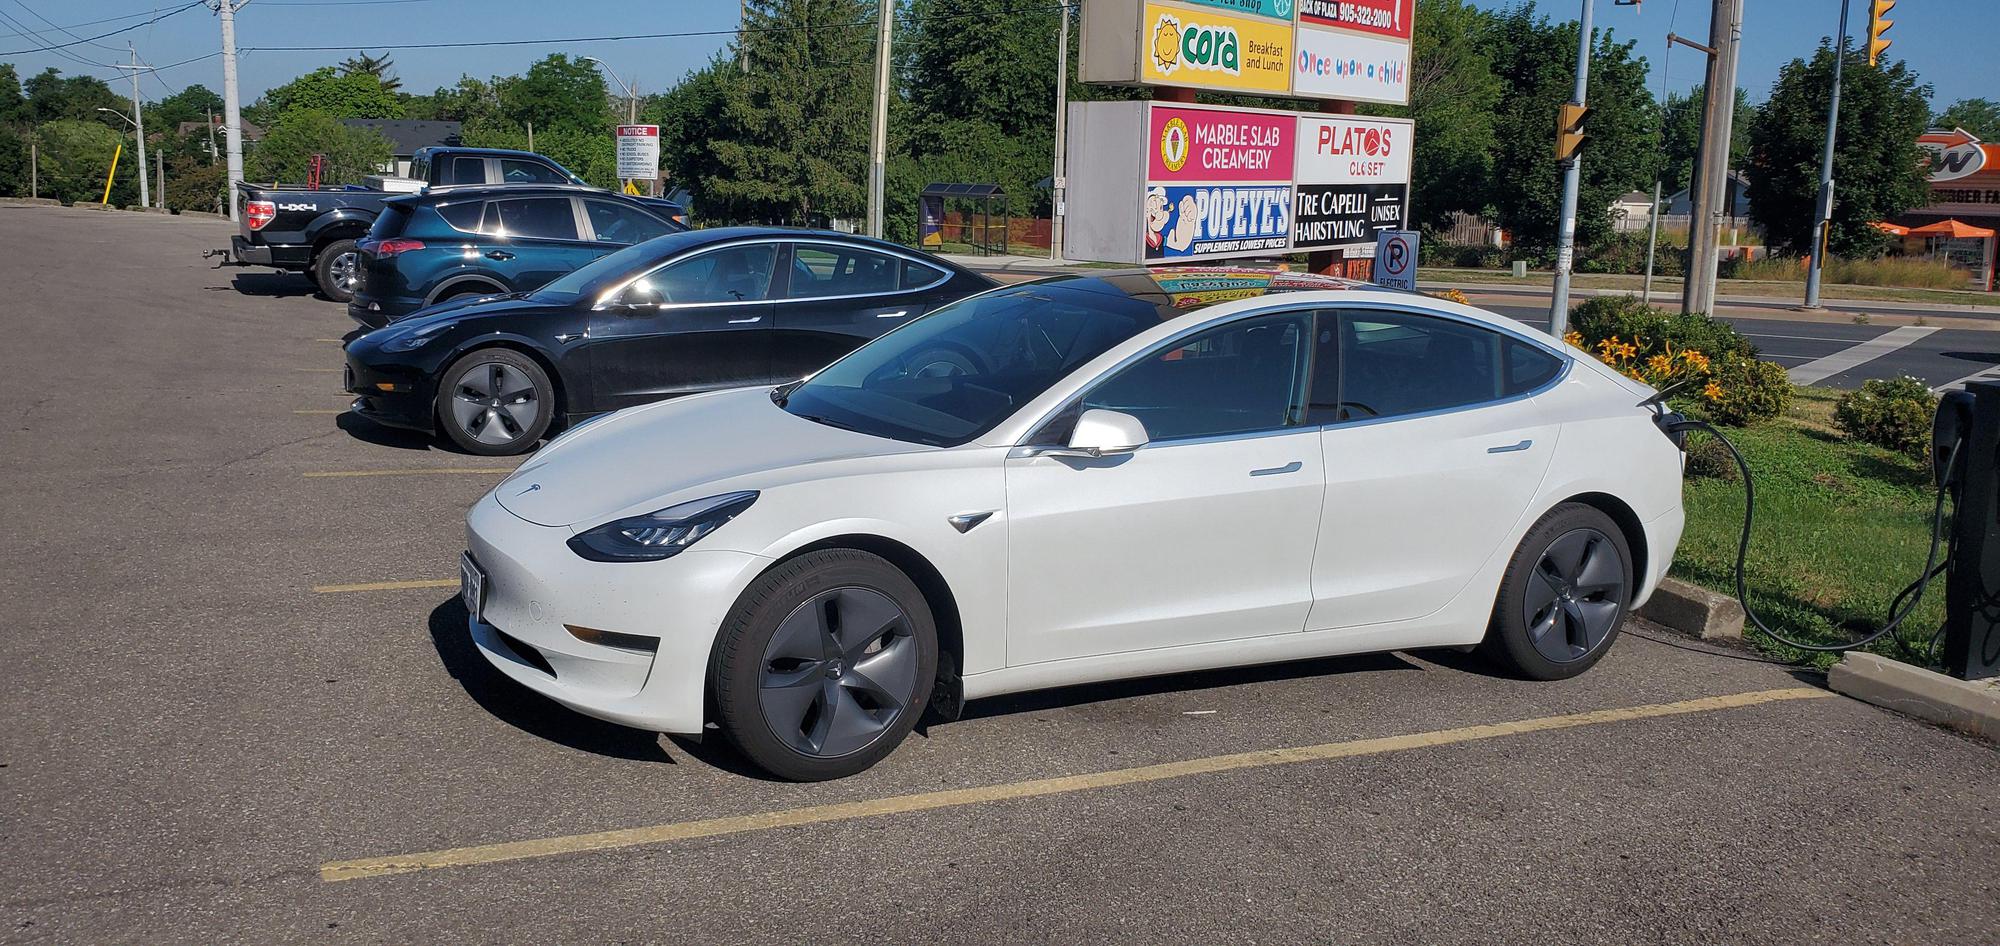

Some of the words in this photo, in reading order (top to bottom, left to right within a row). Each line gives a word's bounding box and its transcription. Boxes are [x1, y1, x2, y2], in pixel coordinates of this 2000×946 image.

[1314, 1, 1321, 16] OF
[1321, 2, 1338, 19] PLAZA
[1339, 2, 1392, 29] 905-322-2000
[1182, 27, 1238, 71] cora
[1248, 41, 1283, 57] Breakfast
[1246, 58, 1260, 70] and
[1262, 59, 1284, 72] Lunch
[1298, 50, 1331, 76] Once
[1336, 58, 1362, 79] upon
[1367, 63, 1374, 79] a
[1378, 60, 1404, 85] child
[623, 127, 648, 136] NOTICE
[1195, 123, 1248, 146] MARBLE
[1250, 126, 1280, 146] SLAB
[1318, 125, 1391, 157] PLATO'S
[1202, 148, 1272, 169] CREAMERY
[1193, 188, 1290, 239] POPEYE'S
[1297, 192, 1319, 216] TRE
[1321, 191, 1367, 216] CAPELLI
[1371, 205, 1401, 222] UNISEX
[1295, 219, 1365, 242] HAIRSTYLING
[1194, 241, 1239, 254] SUPPLEMENTS
[1240, 239, 1265, 251] LOWEST
[1266, 238, 1286, 249] PRICES
[1380, 277, 1408, 290] ELECTRIC
